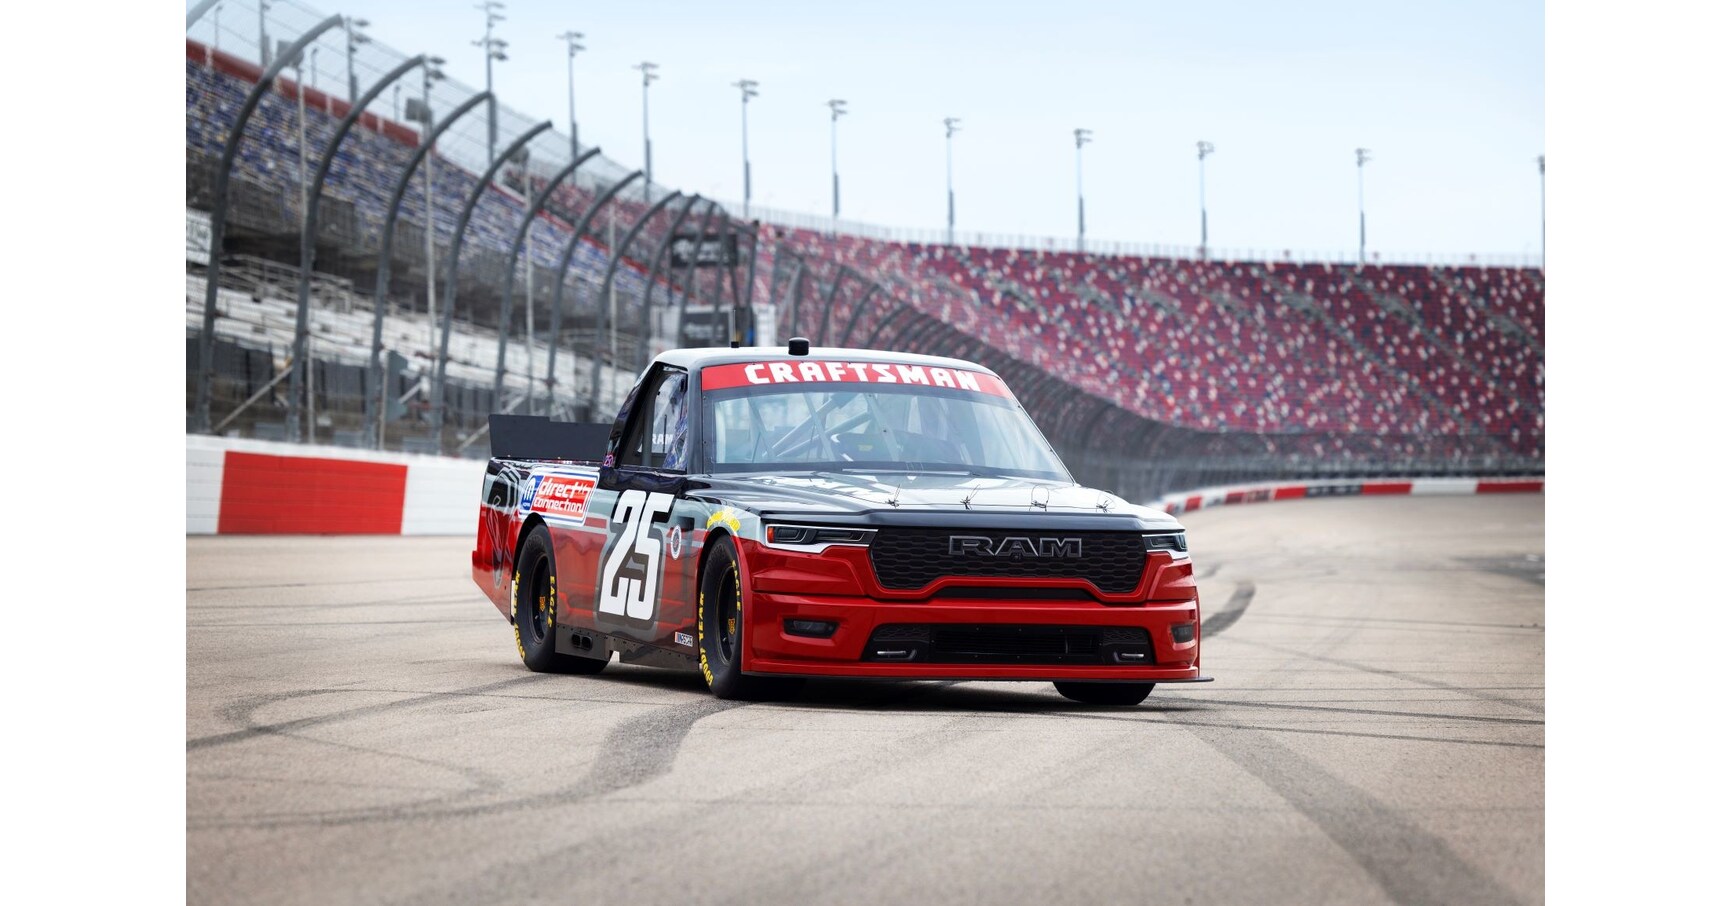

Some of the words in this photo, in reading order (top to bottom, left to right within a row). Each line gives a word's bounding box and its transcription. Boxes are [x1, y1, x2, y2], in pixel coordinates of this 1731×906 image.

[744, 362, 981, 392] CRAFTSMAN
[538, 478, 580, 498] direct
[533, 496, 583, 513] connection
[599, 489, 675, 620] 25
[948, 535, 1082, 557] RAM
